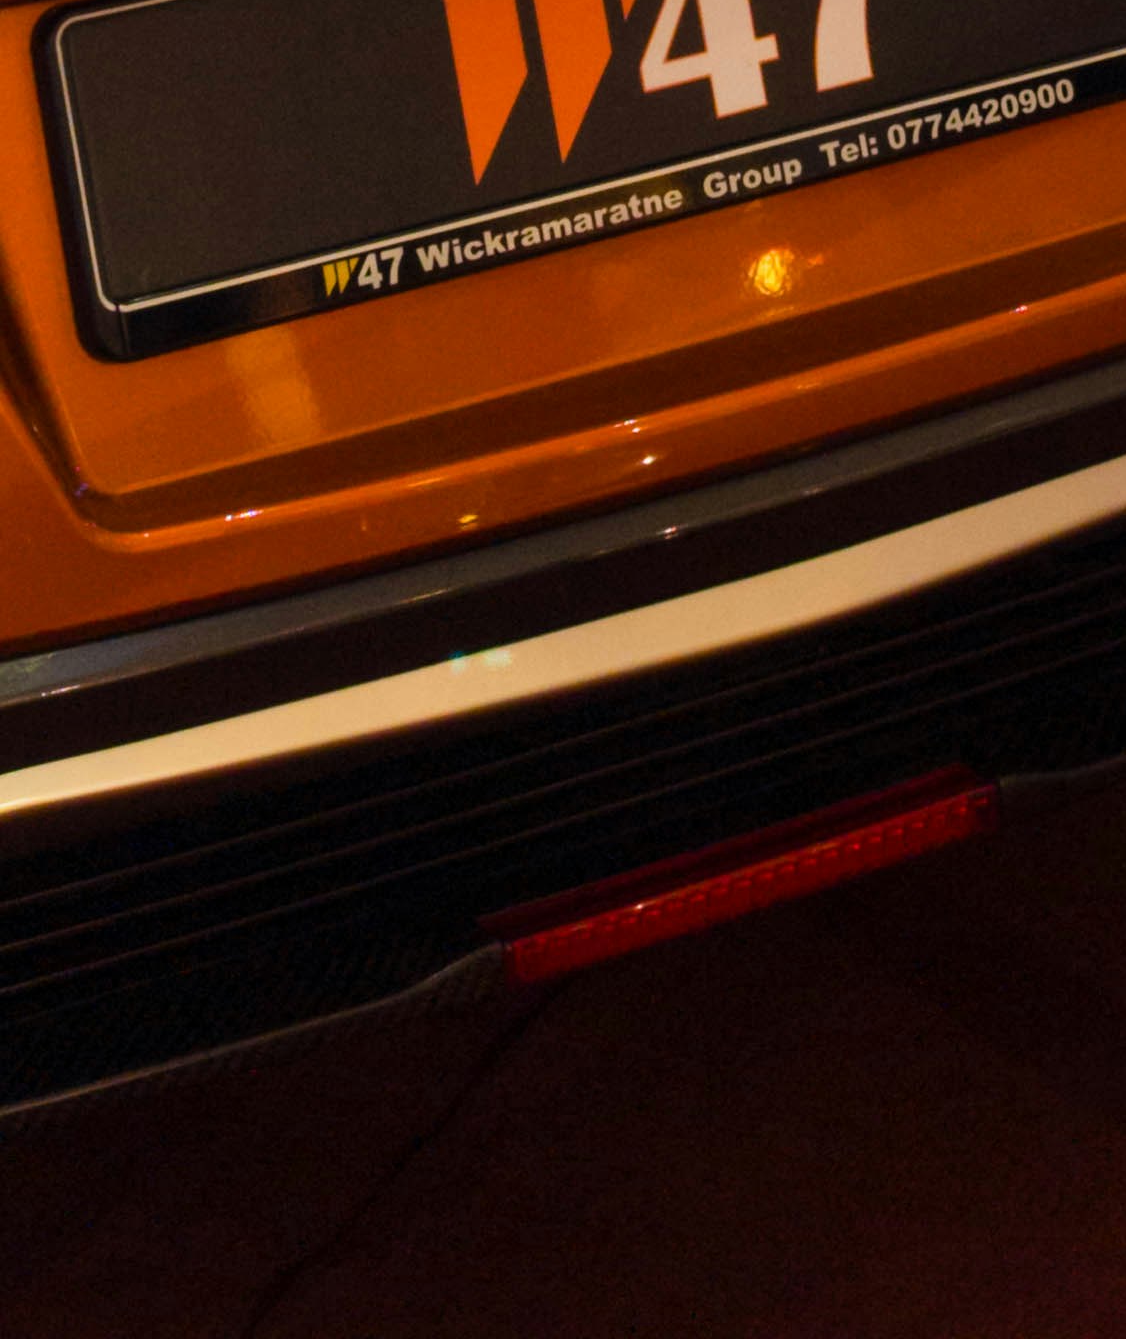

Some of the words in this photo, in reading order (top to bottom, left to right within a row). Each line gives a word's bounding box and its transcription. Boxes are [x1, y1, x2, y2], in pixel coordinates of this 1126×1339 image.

[416, 187, 684, 273] Wickramaratne
[702, 156, 802, 199] Group
[818, 134, 879, 169] Tel:
[886, 78, 1075, 151] 0774420900
